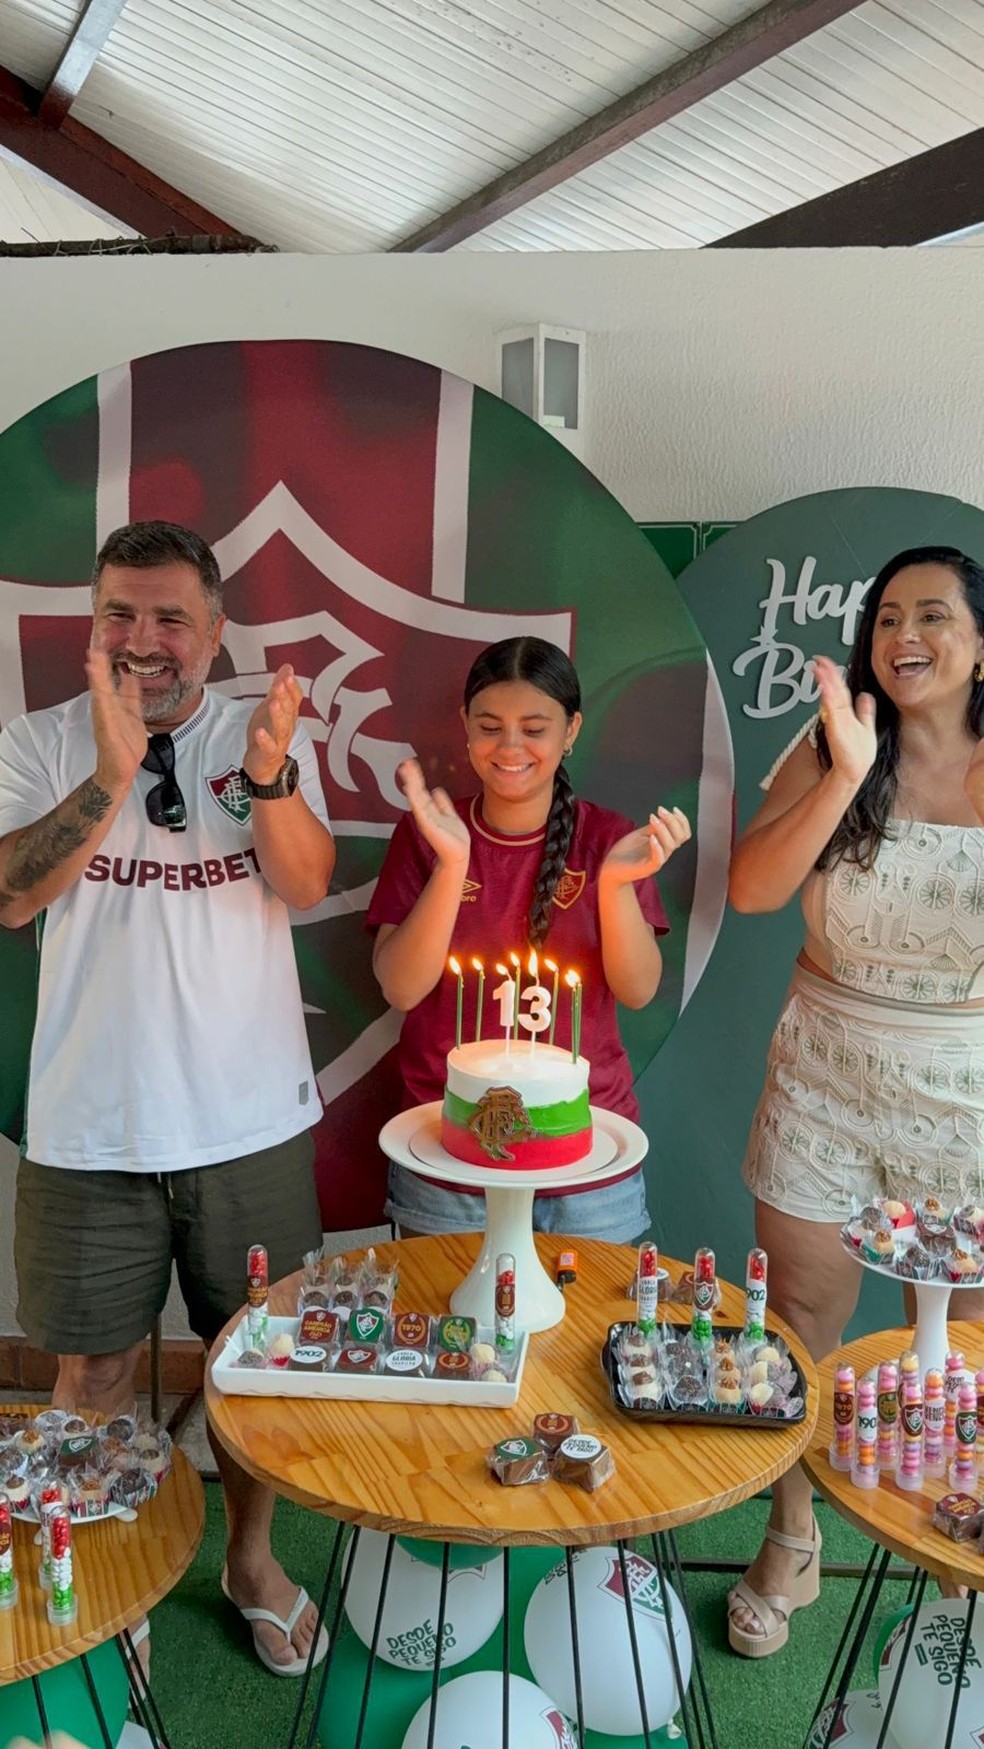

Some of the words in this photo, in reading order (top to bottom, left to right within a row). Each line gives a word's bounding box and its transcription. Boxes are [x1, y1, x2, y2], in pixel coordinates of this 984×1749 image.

[759, 555, 877, 646] Hap
[84, 847, 262, 891] SUPERBET
[493, 979, 552, 1032] 13
[401, 1323, 422, 1331] 1970
[386, 1618, 434, 1649] DESDE
[388, 1622, 454, 1660] PEQUEO
[920, 1622, 939, 1641] TE
[401, 1655, 422, 1666] TE
[928, 1645, 953, 1686] SIGO
